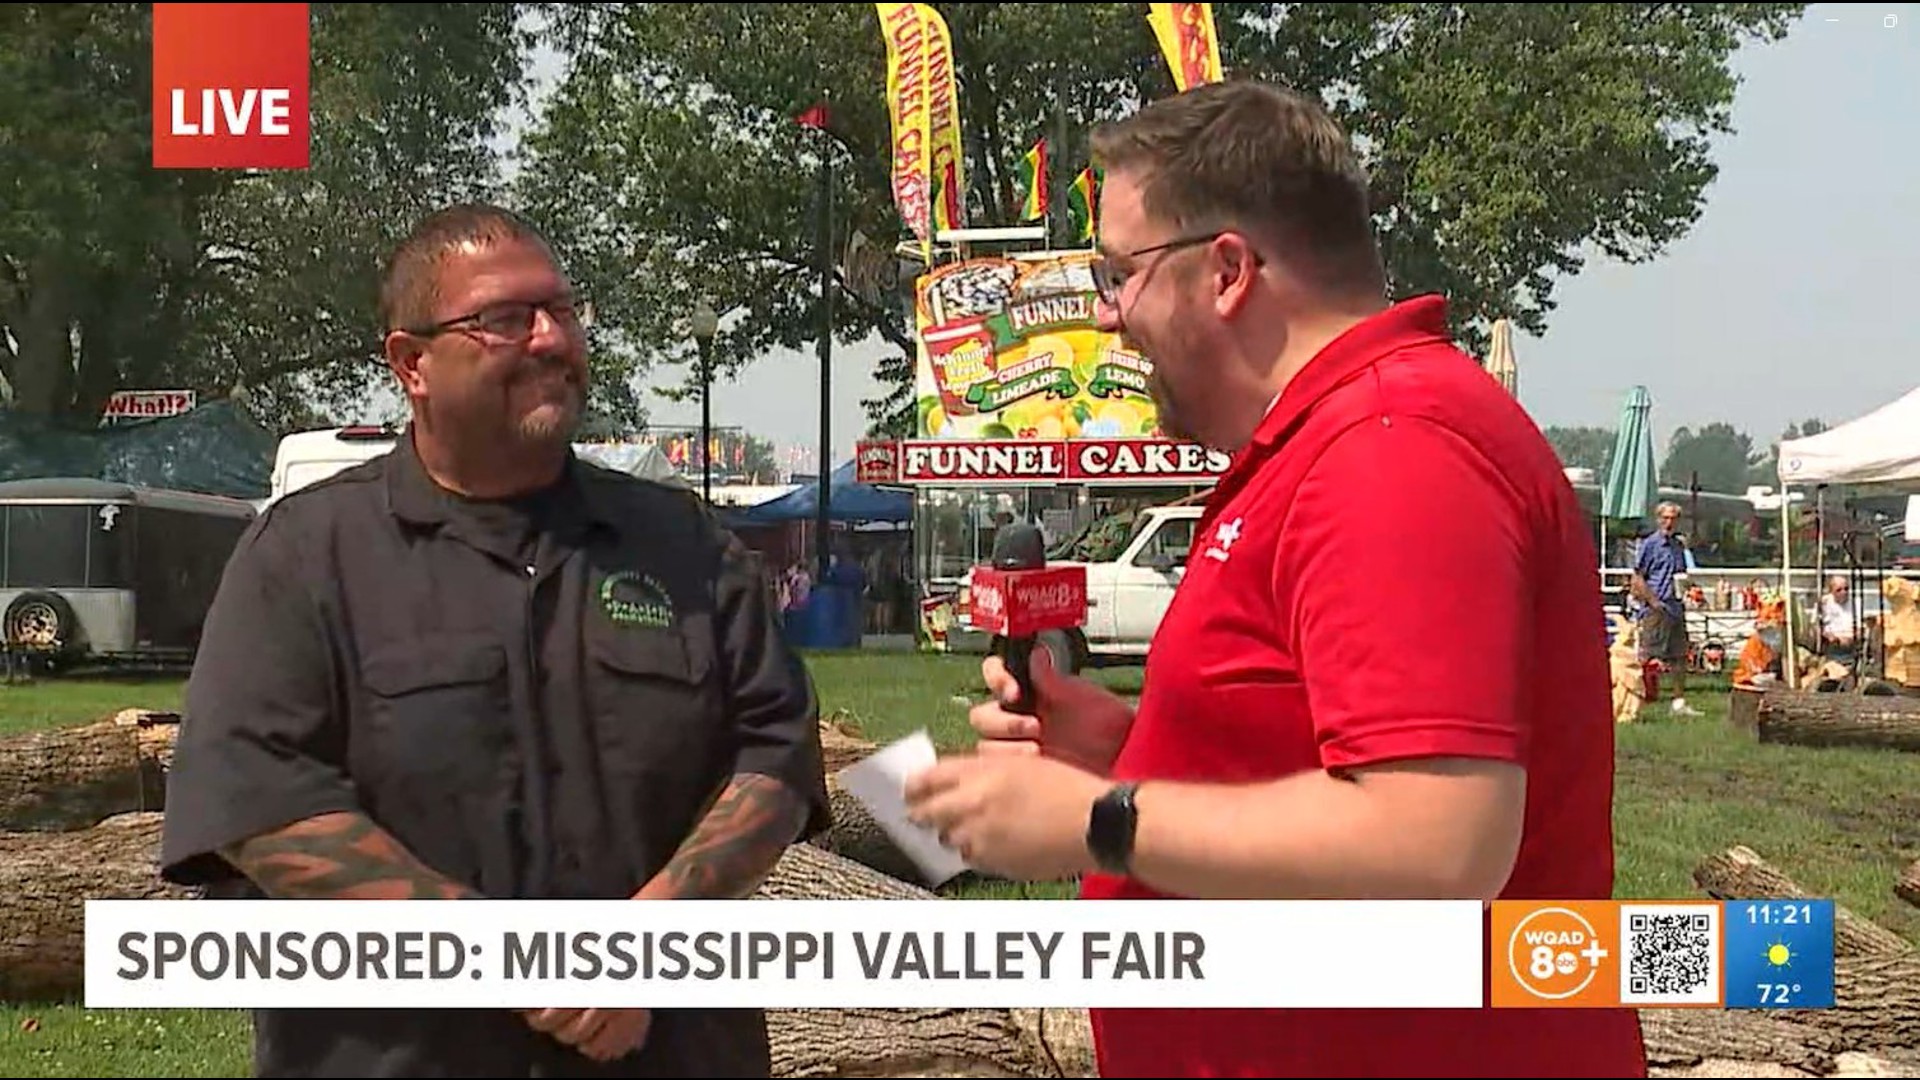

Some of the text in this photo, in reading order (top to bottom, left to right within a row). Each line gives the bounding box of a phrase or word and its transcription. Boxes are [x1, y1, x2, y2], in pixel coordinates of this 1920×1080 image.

[886, 3, 927, 226] FUNNEL CAKES
[1011, 295, 1091, 330] FUNNEL
[998, 353, 1053, 384] CHERRY
[992, 371, 1062, 404] LIMEADE
[905, 445, 1062, 476] FUNNEL
[1081, 444, 1231, 475] CAKES
